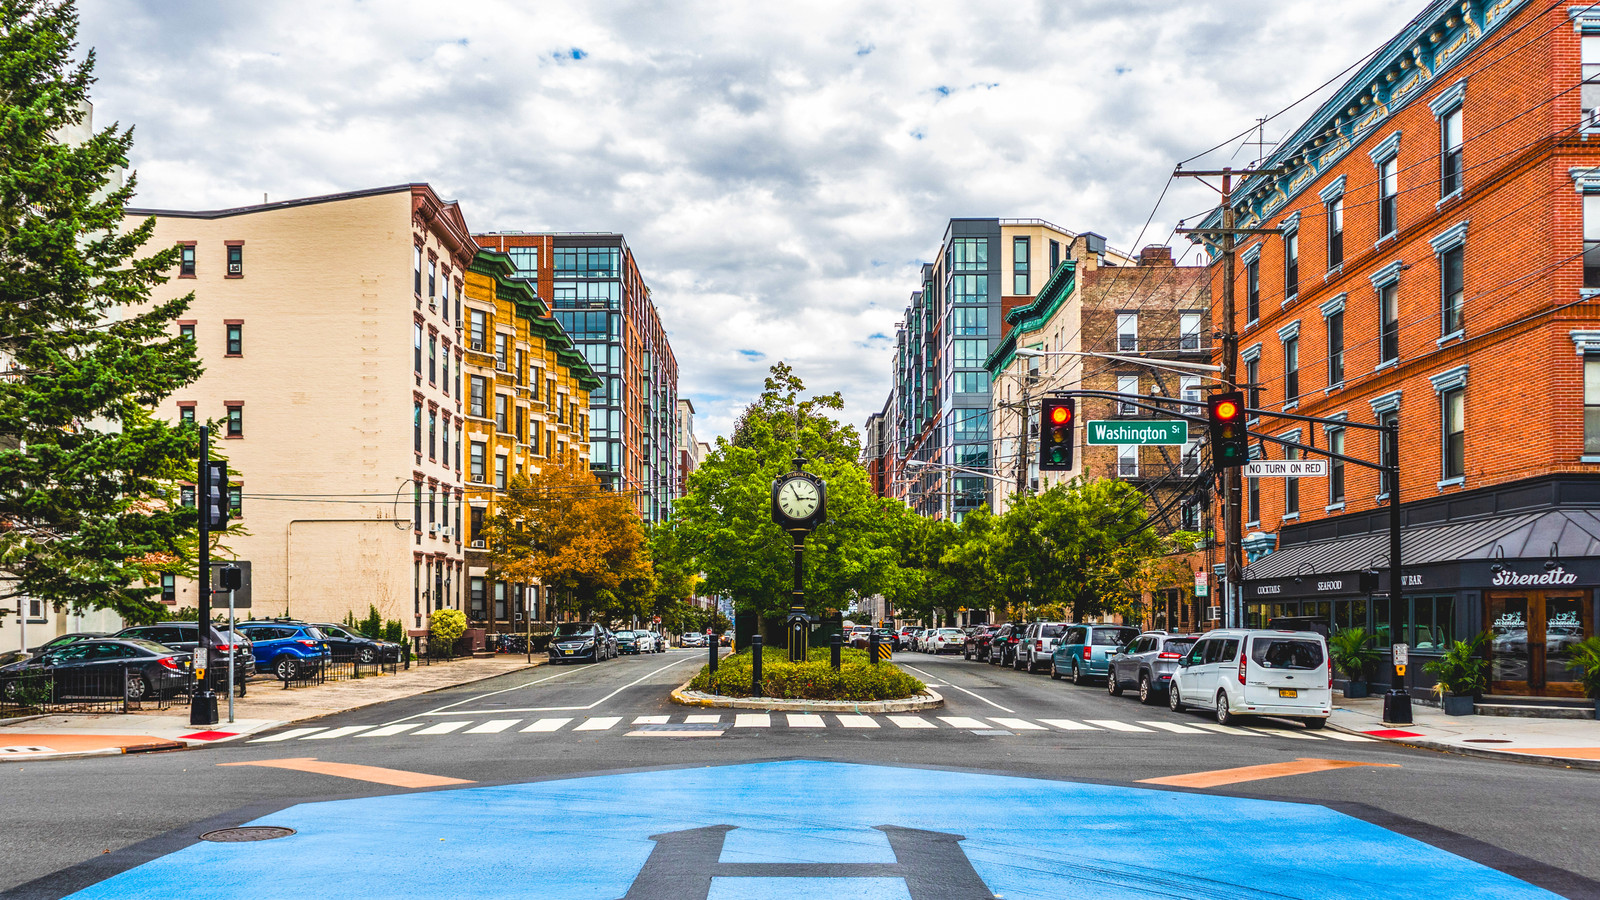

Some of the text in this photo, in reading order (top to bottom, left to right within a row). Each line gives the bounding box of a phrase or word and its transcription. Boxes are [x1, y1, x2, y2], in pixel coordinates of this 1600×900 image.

[1095, 425, 1180, 443] Washington St
[1249, 463, 1321, 474] NO TURN ON RED
[1408, 575, 1423, 586] BAR
[1492, 566, 1578, 586] Sirenetta
[1257, 584, 1281, 595] COCKTAILS
[1317, 580, 1342, 591] SEAFOOD
